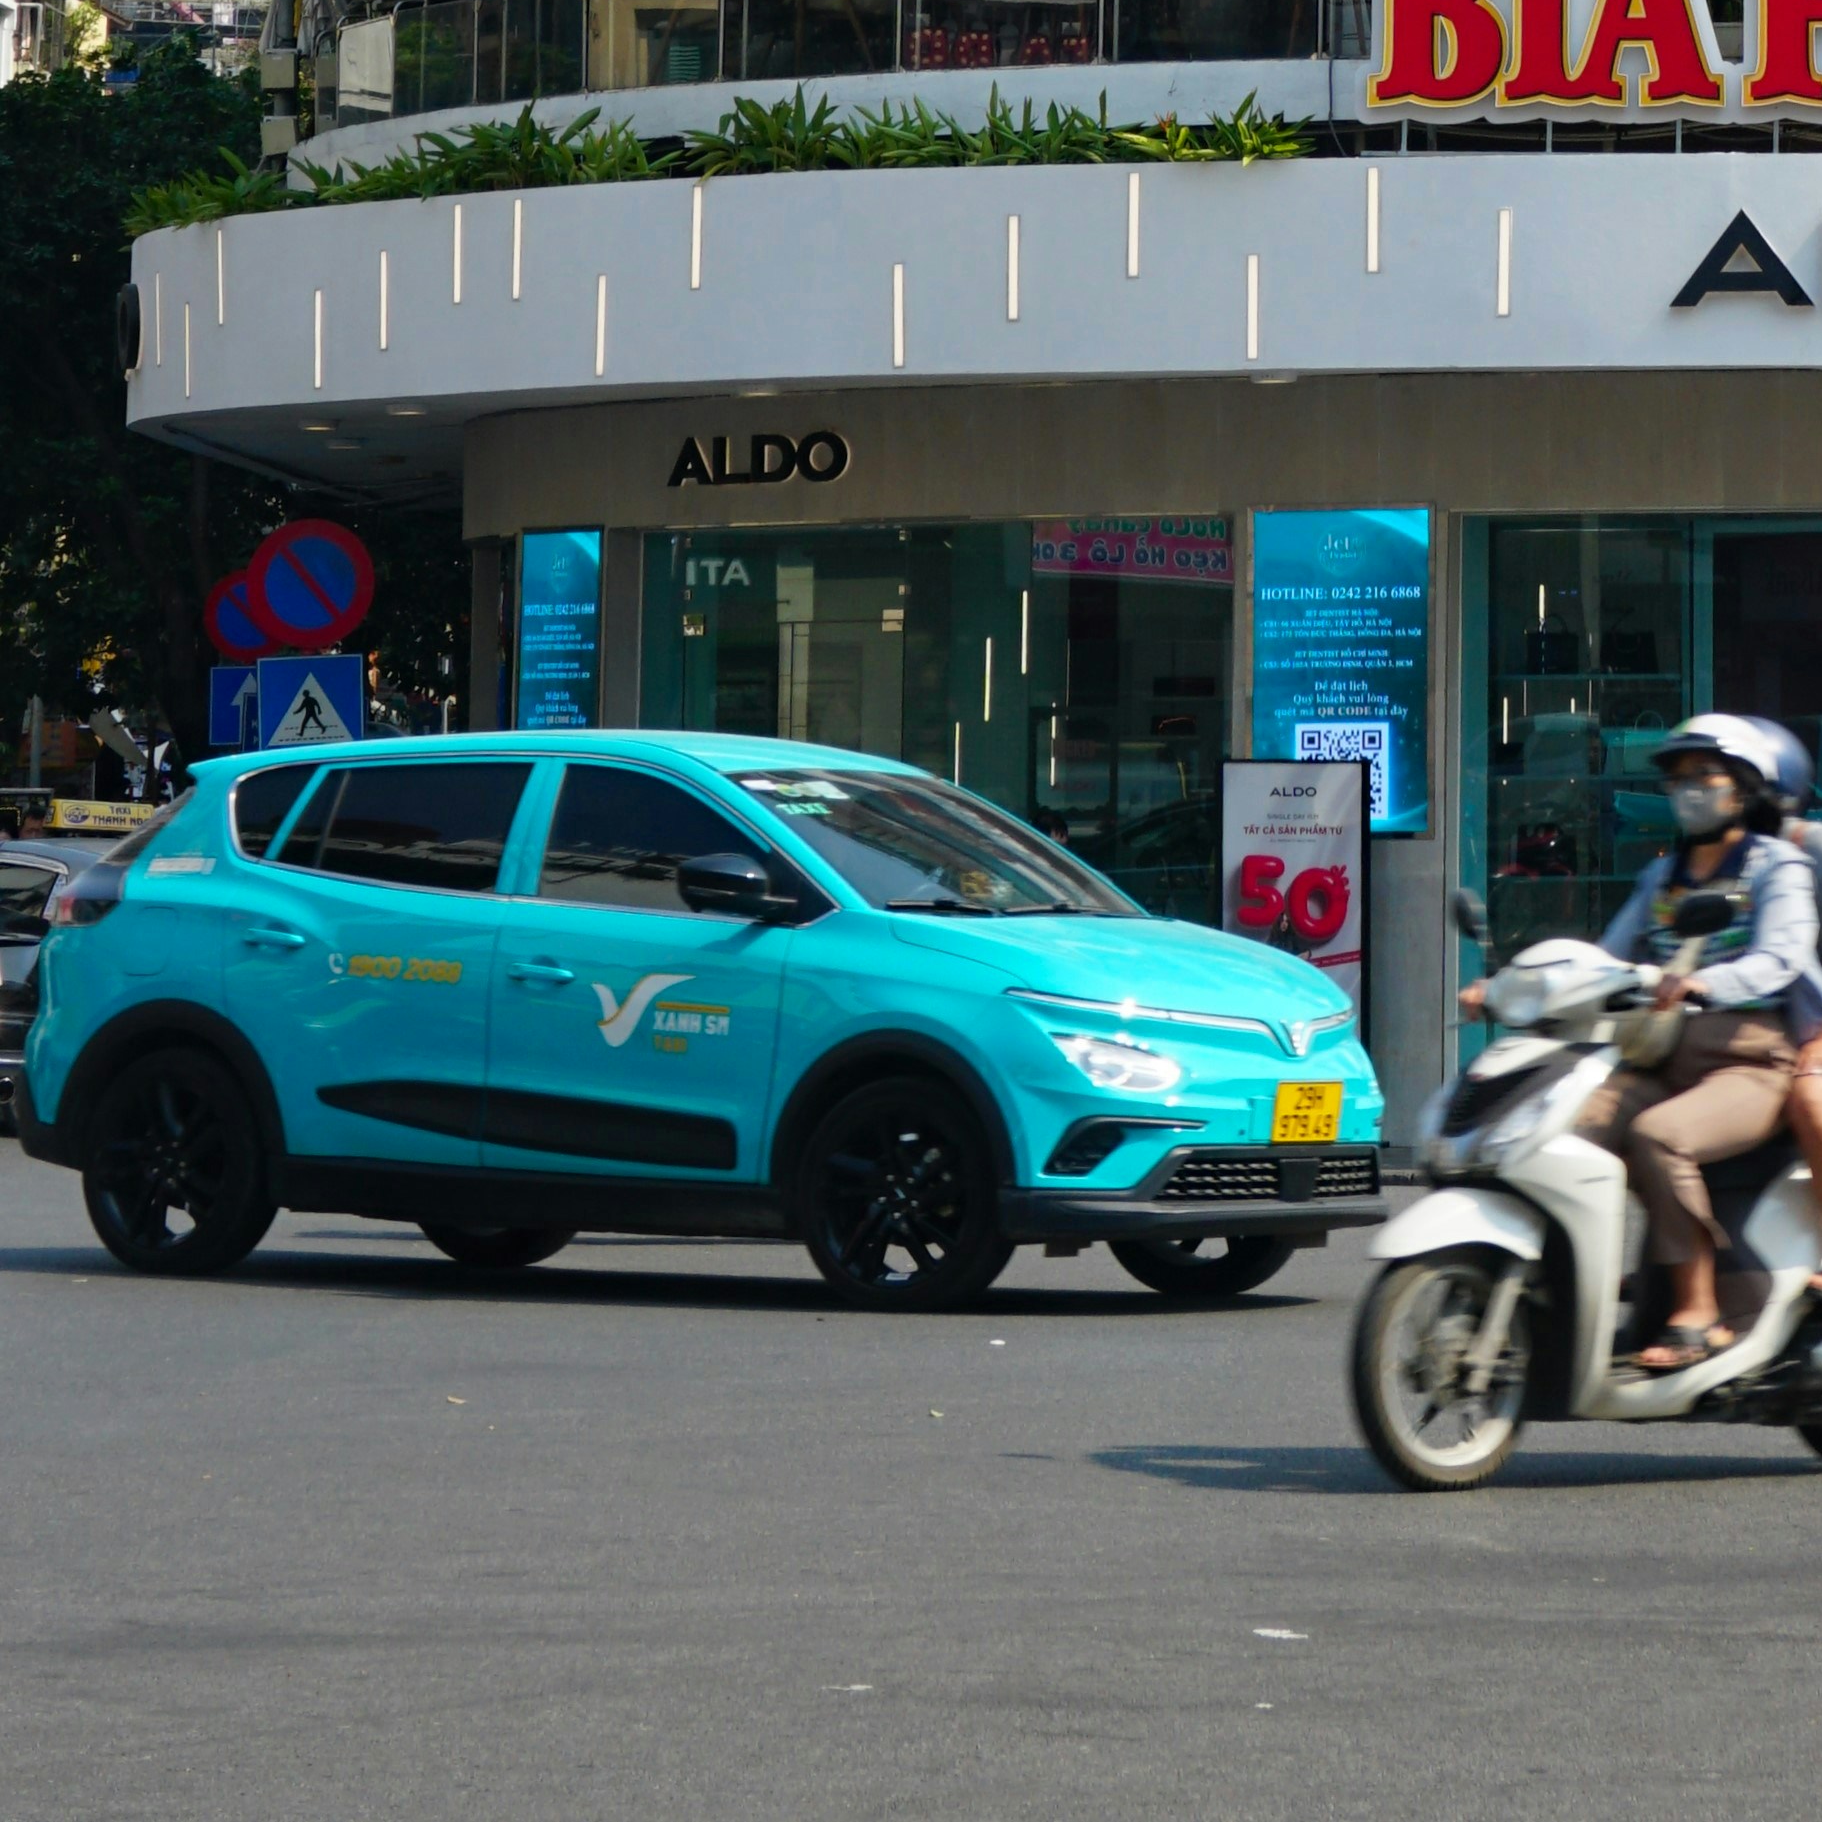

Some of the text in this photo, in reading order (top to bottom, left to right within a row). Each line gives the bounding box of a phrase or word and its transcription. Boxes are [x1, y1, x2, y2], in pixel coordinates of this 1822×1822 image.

[667, 430, 850, 488] ALDO
[1261, 586, 1421, 600] HOTLINE: 0242 216 6868
[1317, 707, 1335, 717] QR
[1338, 706, 1372, 716] CODE
[1269, 786, 1317, 798] ALDO
[1243, 825, 1260, 835] TẤT
[1278, 823, 1296, 835] SẢN
[1299, 822, 1327, 835] PHẨM
